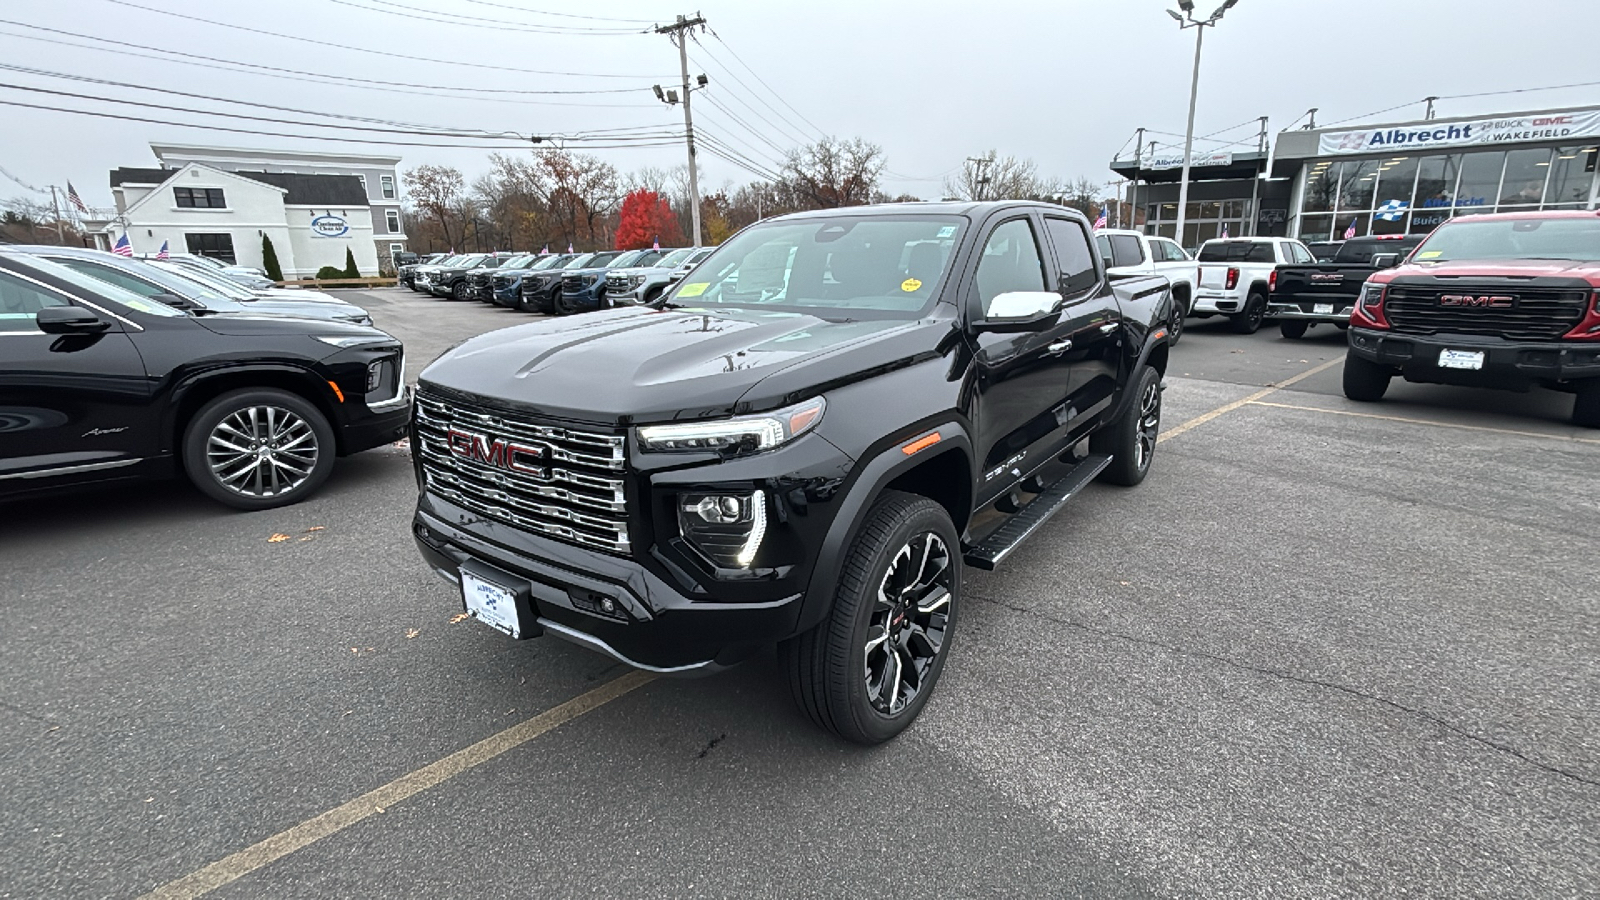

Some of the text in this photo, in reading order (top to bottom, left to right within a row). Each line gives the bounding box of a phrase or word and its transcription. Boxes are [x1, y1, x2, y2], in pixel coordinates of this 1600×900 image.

[1494, 116, 1574, 129] BUICK GMC
[1369, 124, 1472, 146] Albrecht
[1493, 128, 1570, 141] WAKEFIELD
[1441, 294, 1513, 307] GMC
[447, 426, 543, 477] GMC
